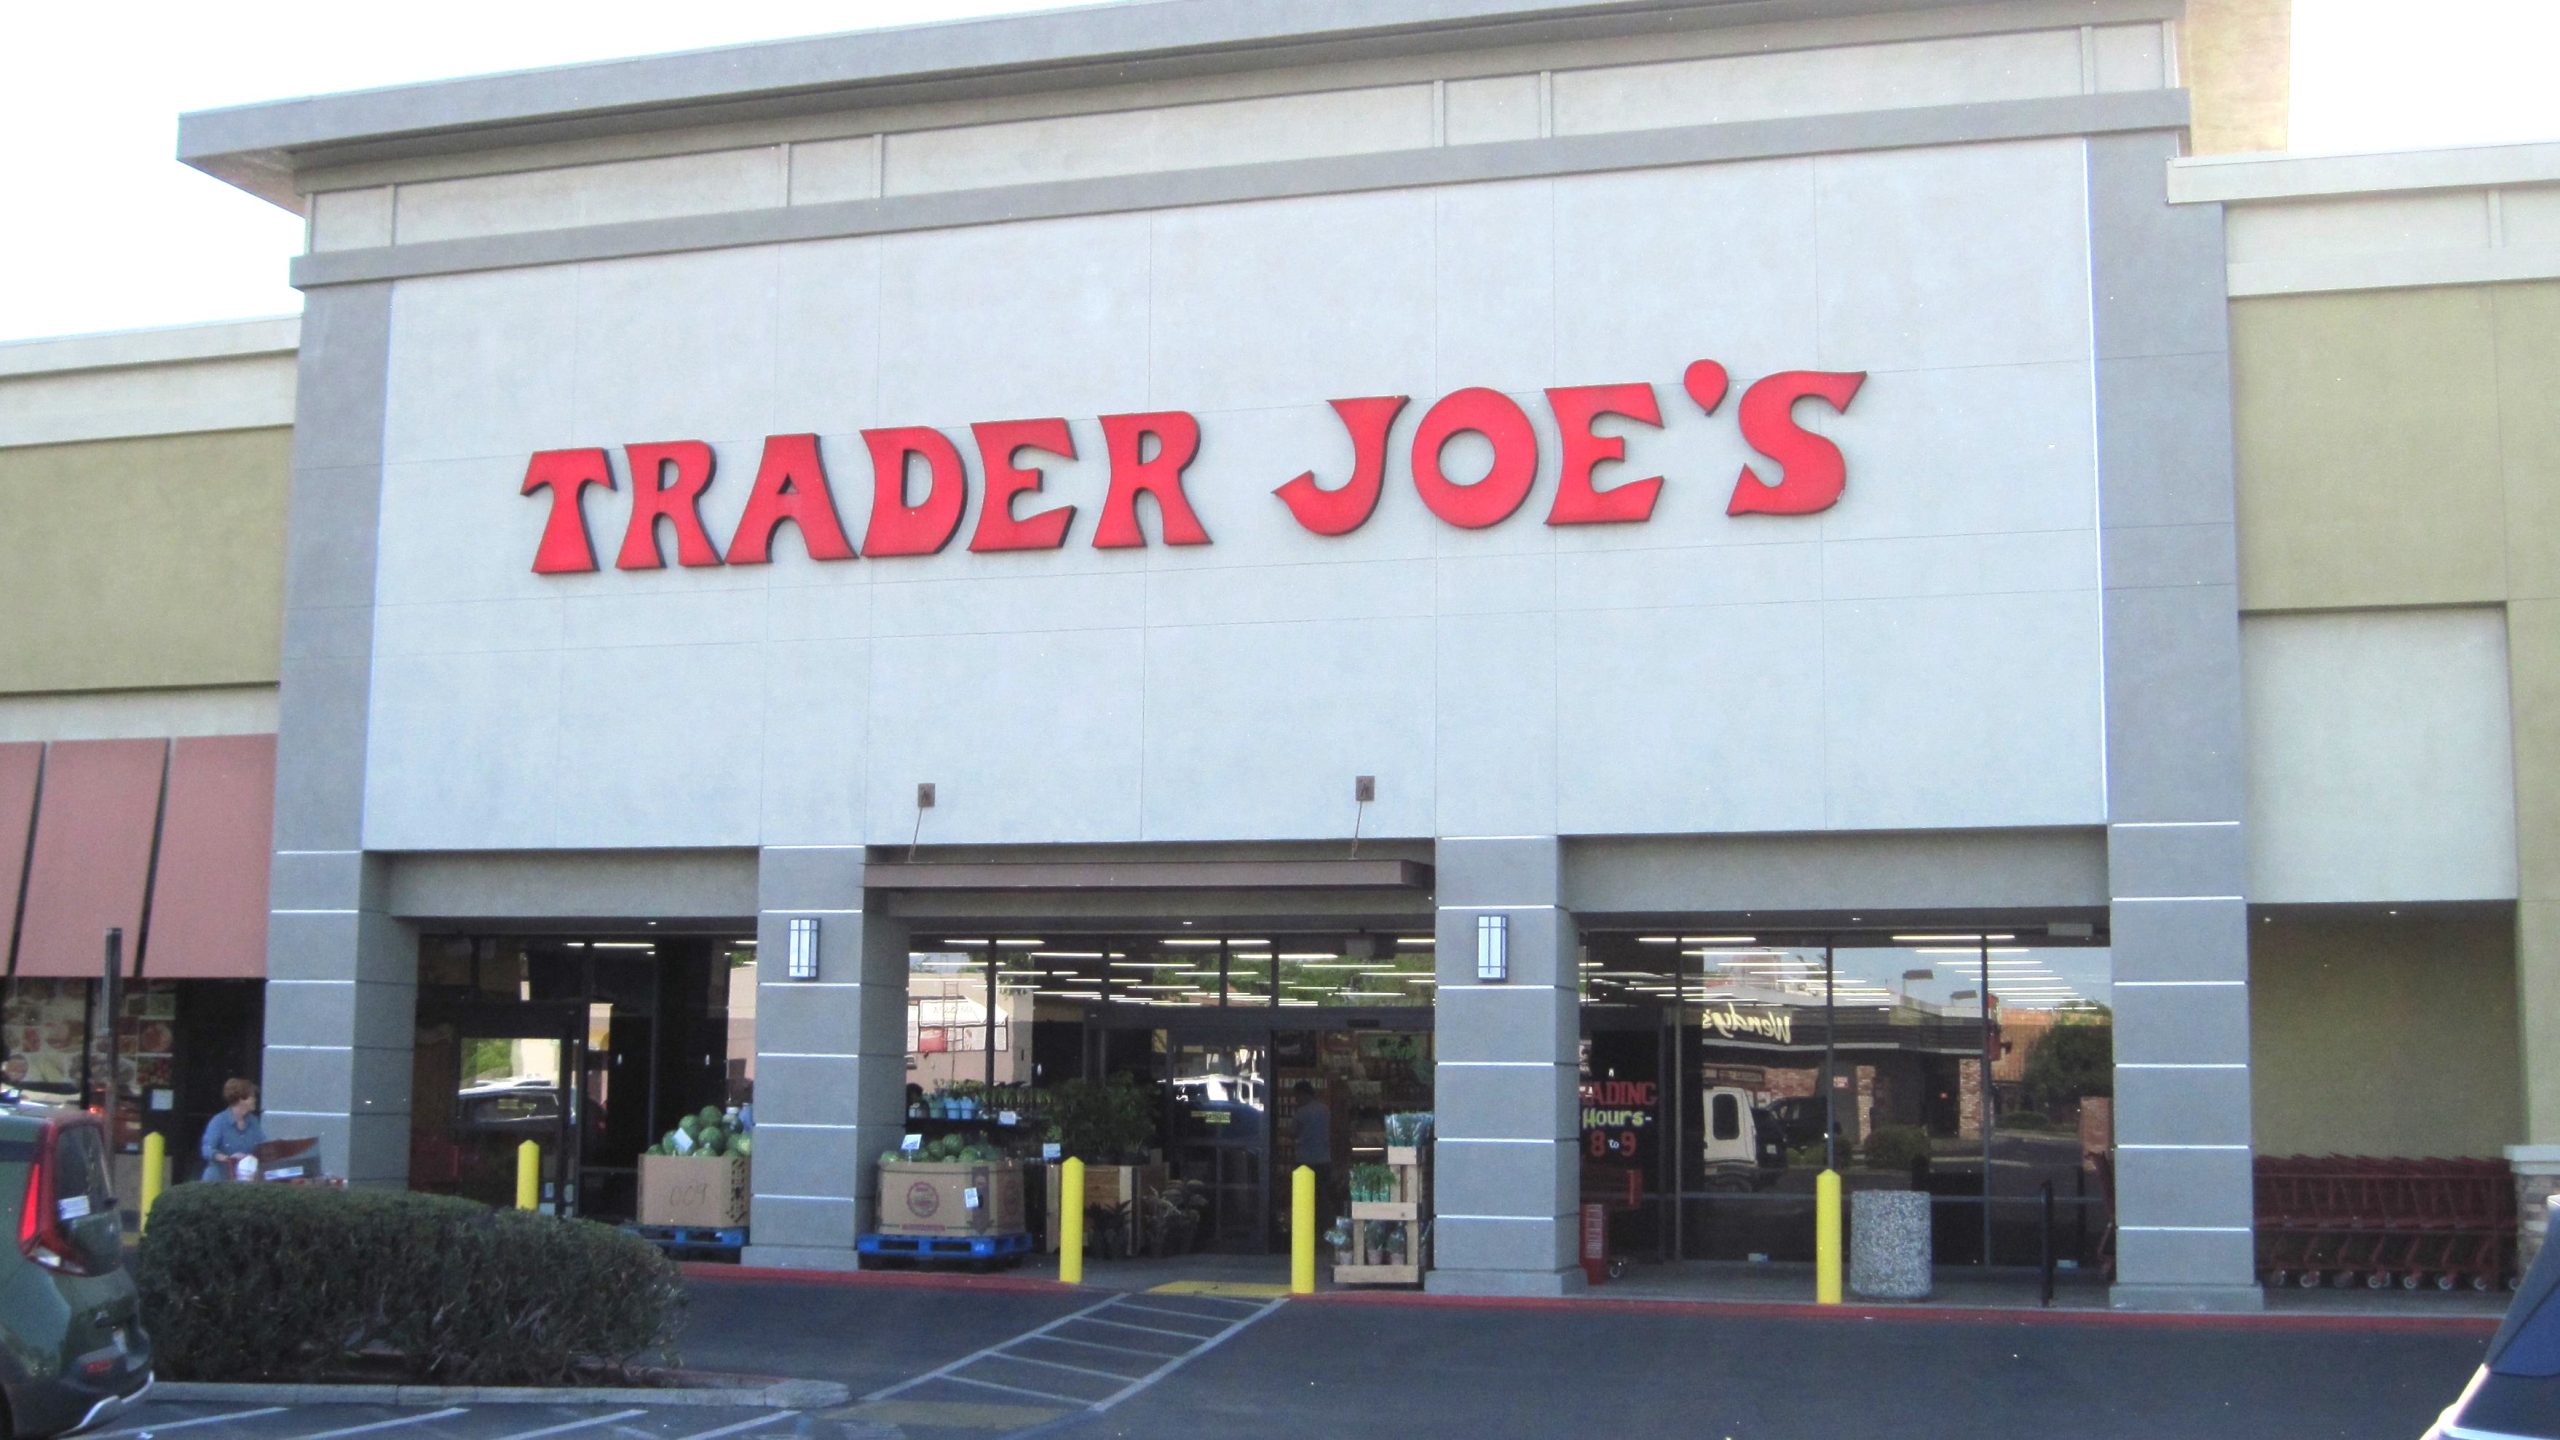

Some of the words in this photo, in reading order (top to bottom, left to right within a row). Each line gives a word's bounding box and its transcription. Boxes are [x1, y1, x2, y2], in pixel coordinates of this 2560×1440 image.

[519, 410, 1213, 575] TRADER
[1273, 358, 1867, 538] JOE'S
[1591, 1130, 1606, 1157] 8
[1608, 1139, 1619, 1149] to
[1620, 1130, 1637, 1157] 9
